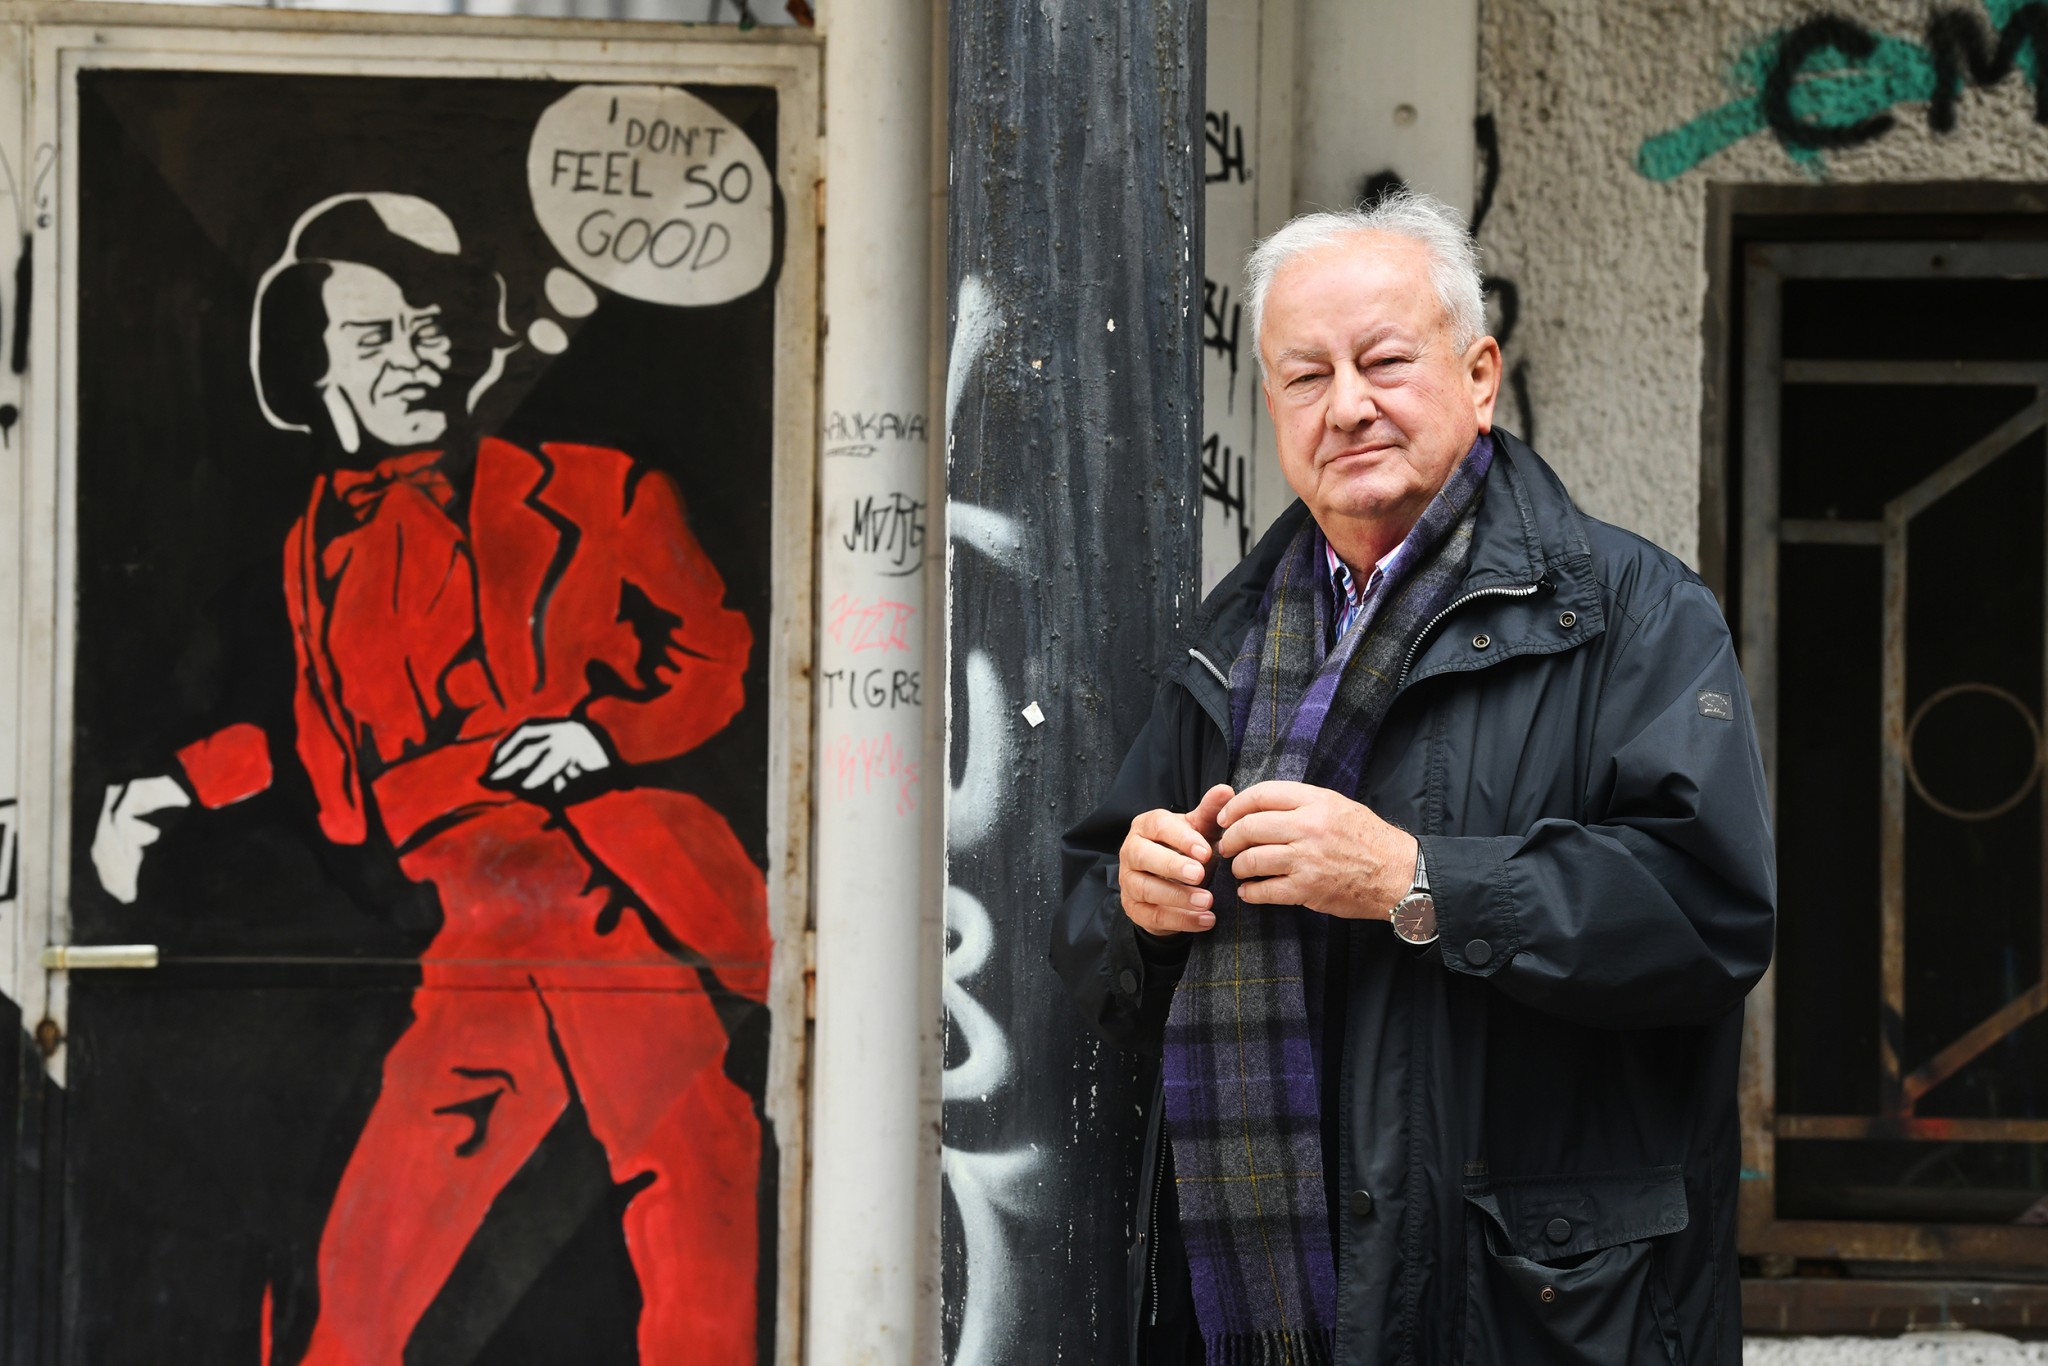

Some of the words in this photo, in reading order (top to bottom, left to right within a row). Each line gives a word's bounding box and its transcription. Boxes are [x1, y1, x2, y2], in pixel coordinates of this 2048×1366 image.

[551, 148, 653, 198] FEEL
[684, 161, 752, 209] SO
[577, 209, 731, 271] GOOD
[824, 668, 922, 710] TIGRE
